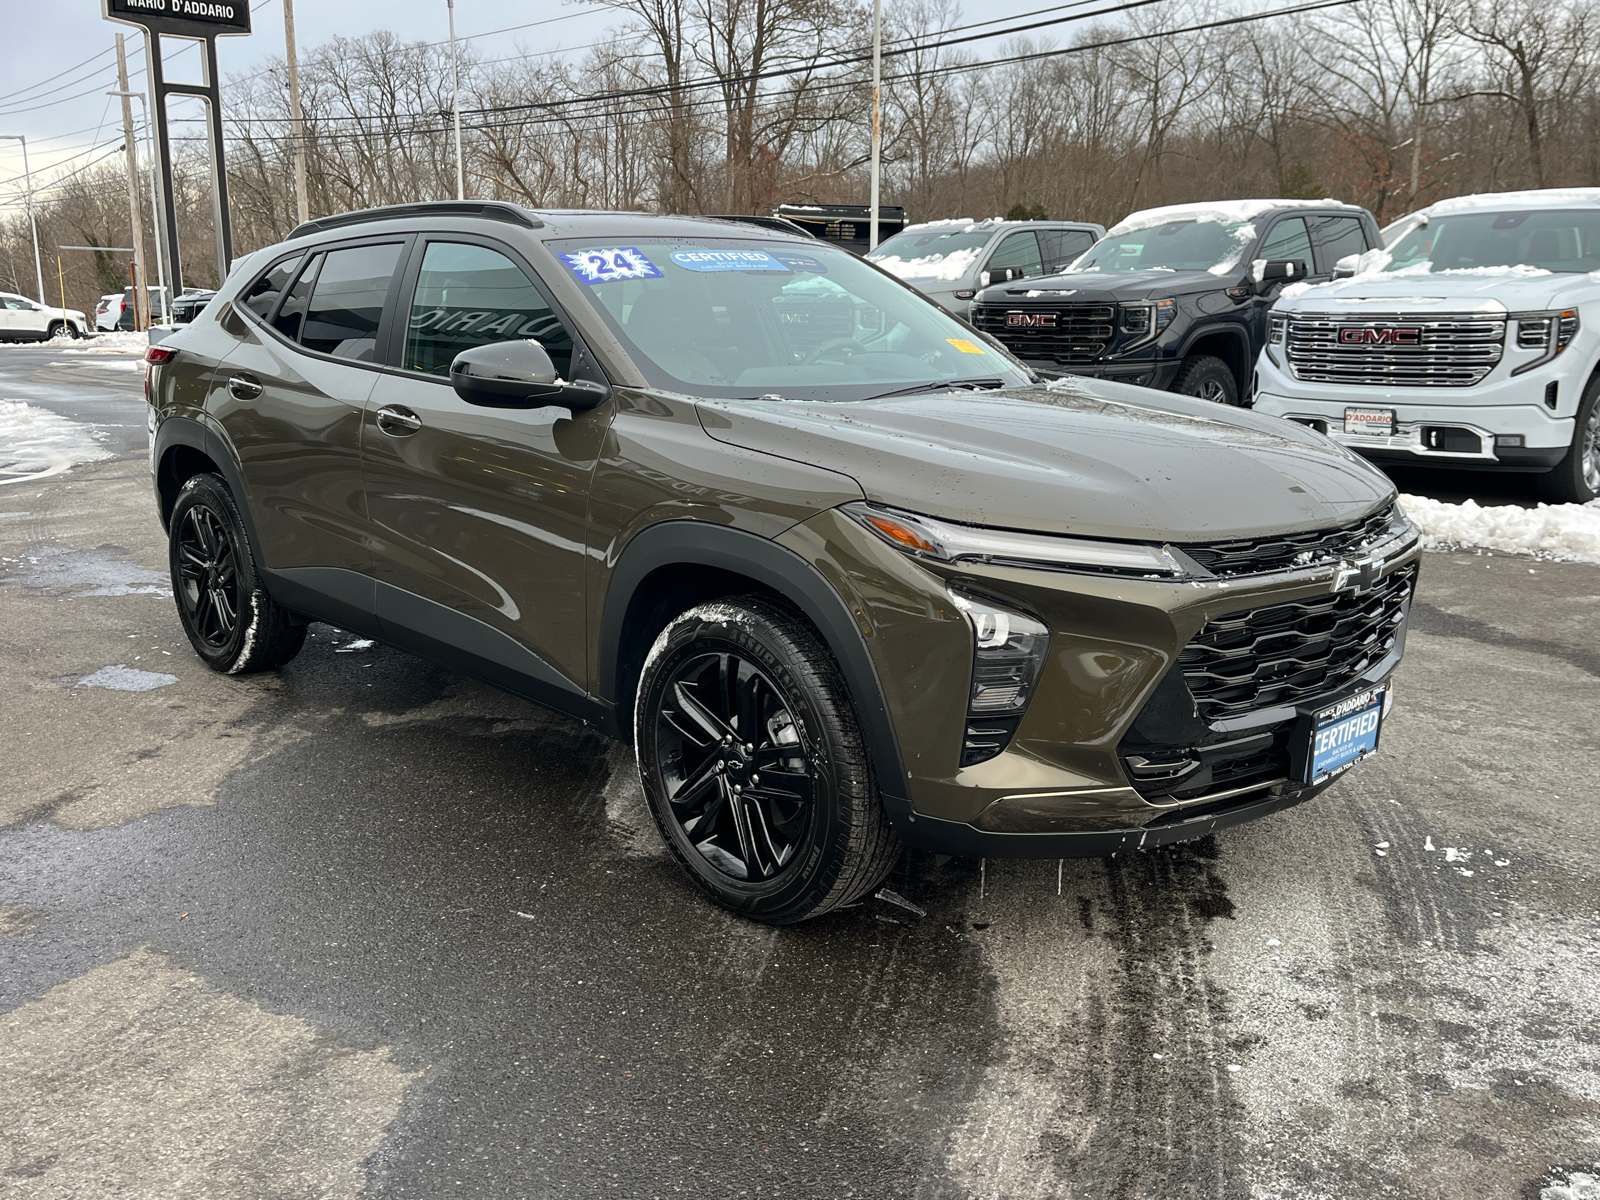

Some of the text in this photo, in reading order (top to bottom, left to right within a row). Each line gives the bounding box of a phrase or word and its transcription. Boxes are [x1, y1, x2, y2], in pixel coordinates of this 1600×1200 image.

[172, 0, 234, 19] D'ADDARIO
[588, 253, 634, 275] 24
[674, 252, 769, 262] CERTIFIED
[781, 313, 809, 324] MC
[1006, 314, 1056, 327] GMC
[1341, 328, 1419, 344] GMC
[1345, 414, 1392, 423] D'ADDARIO
[1336, 691, 1371, 716] D'ADDARIO
[1314, 710, 1379, 756] CERTIFIED
[1330, 760, 1355, 778] SHELTON
